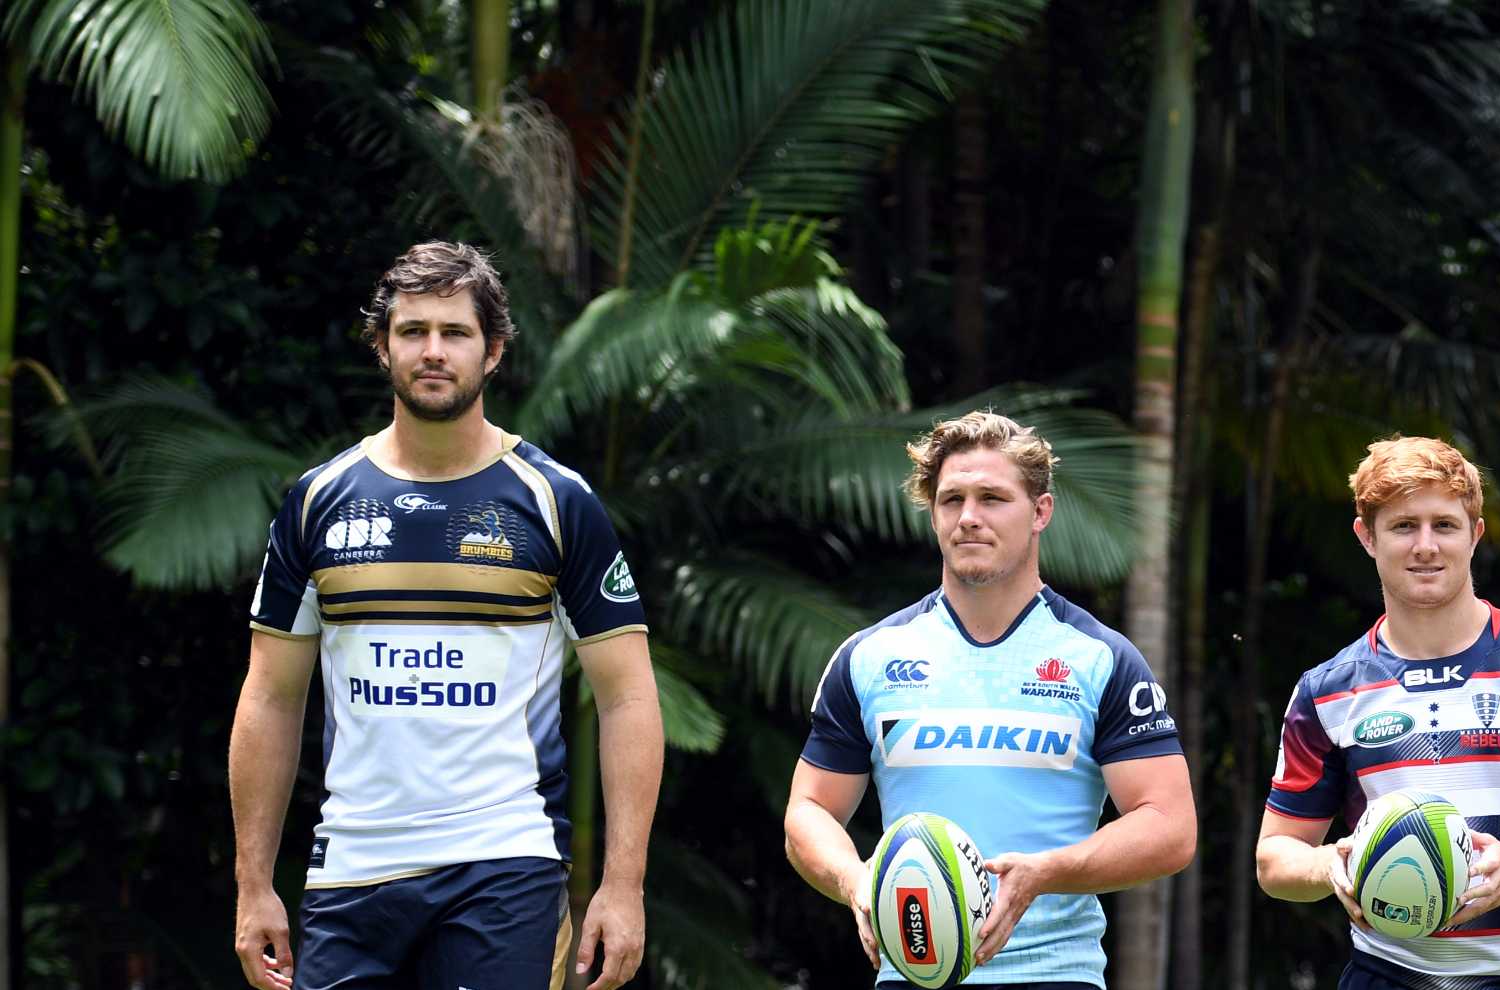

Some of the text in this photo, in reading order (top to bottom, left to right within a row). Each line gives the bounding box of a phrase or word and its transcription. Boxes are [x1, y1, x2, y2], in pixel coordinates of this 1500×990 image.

[459, 544, 513, 559] BRUMBIES
[369, 641, 464, 669] Trade
[1404, 664, 1465, 687] BLK
[349, 677, 497, 707] Plus500
[1020, 687, 1081, 701] WARATAHS
[1363, 715, 1394, 732] LAND
[1366, 724, 1404, 740] ROVER
[914, 725, 1072, 756] DAIKIN
[907, 903, 927, 954] Swisse
